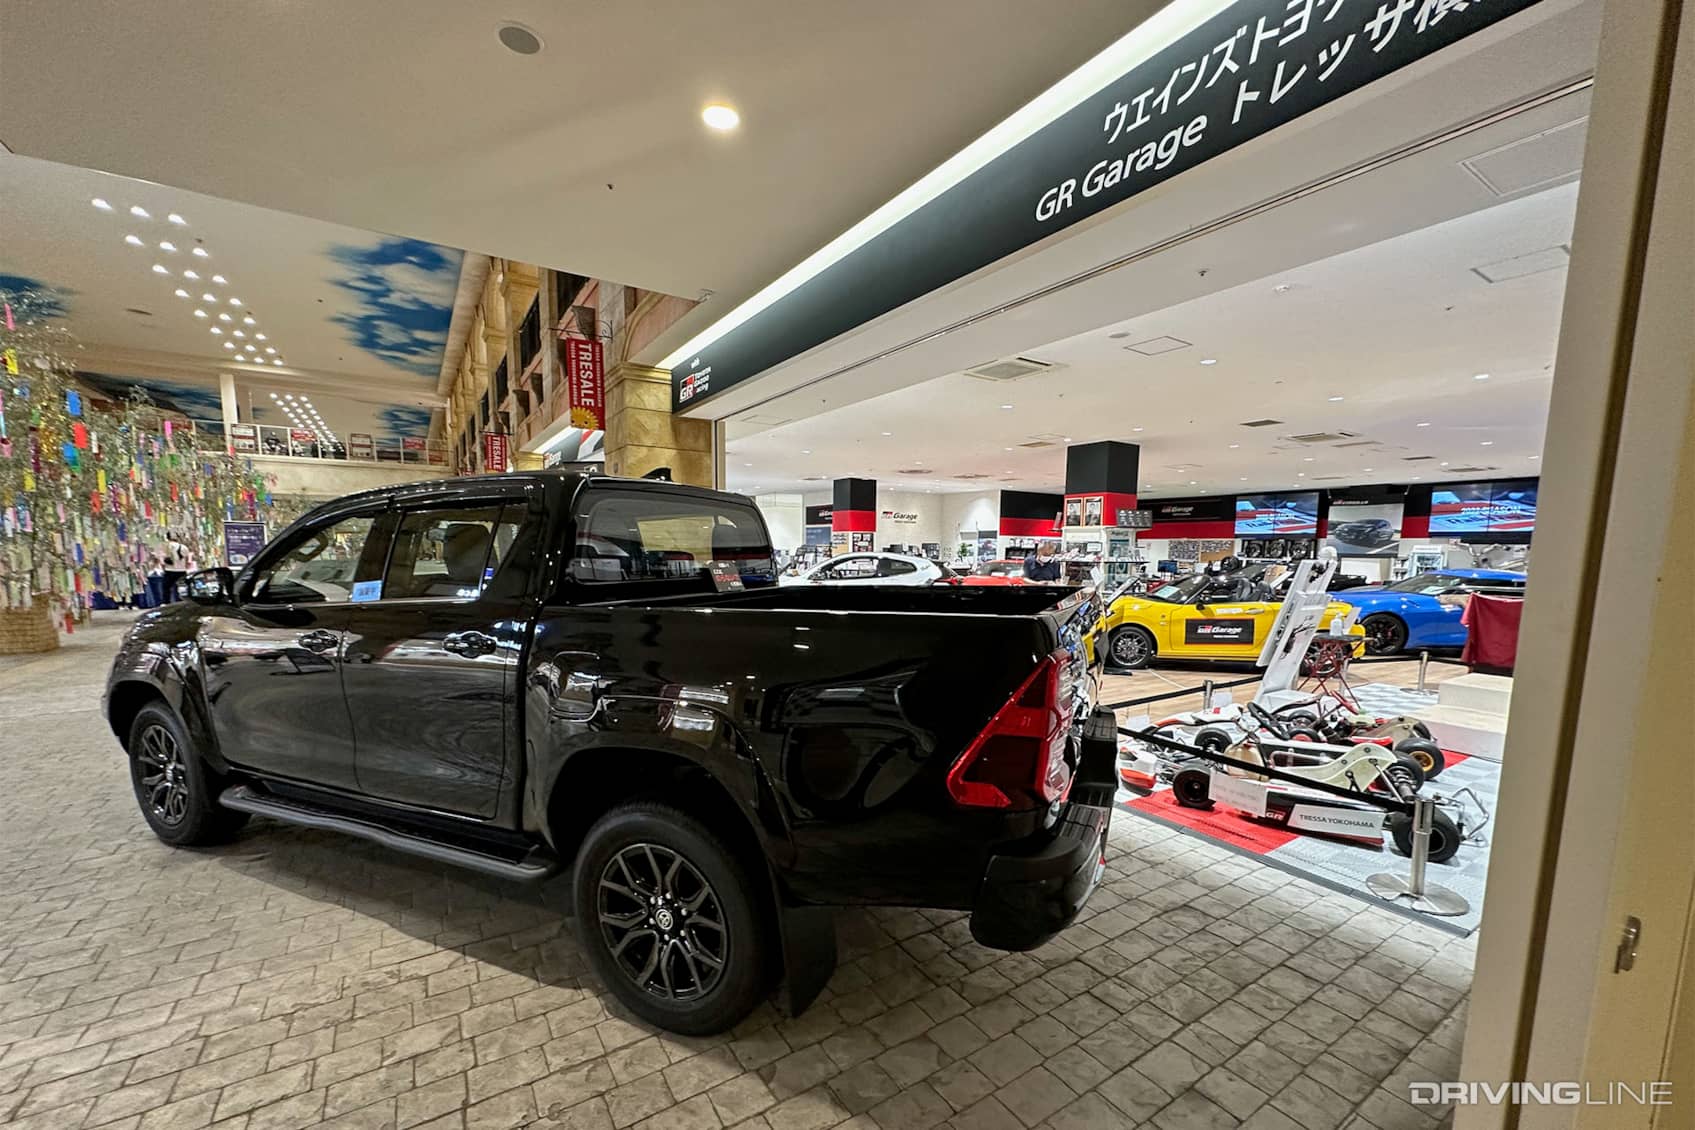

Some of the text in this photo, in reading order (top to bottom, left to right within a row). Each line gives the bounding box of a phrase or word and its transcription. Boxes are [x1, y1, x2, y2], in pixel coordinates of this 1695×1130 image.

[1035, 0, 1480, 222] GR Garage トレッサ
[578, 343, 595, 407] TRESALE
[680, 383, 695, 401] GR
[492, 436, 502, 470] TRESALE
[893, 511, 918, 521] Garage
[1211, 626, 1243, 635] Garage
[1300, 814, 1375, 829] TRESSA YOKOHAMA
